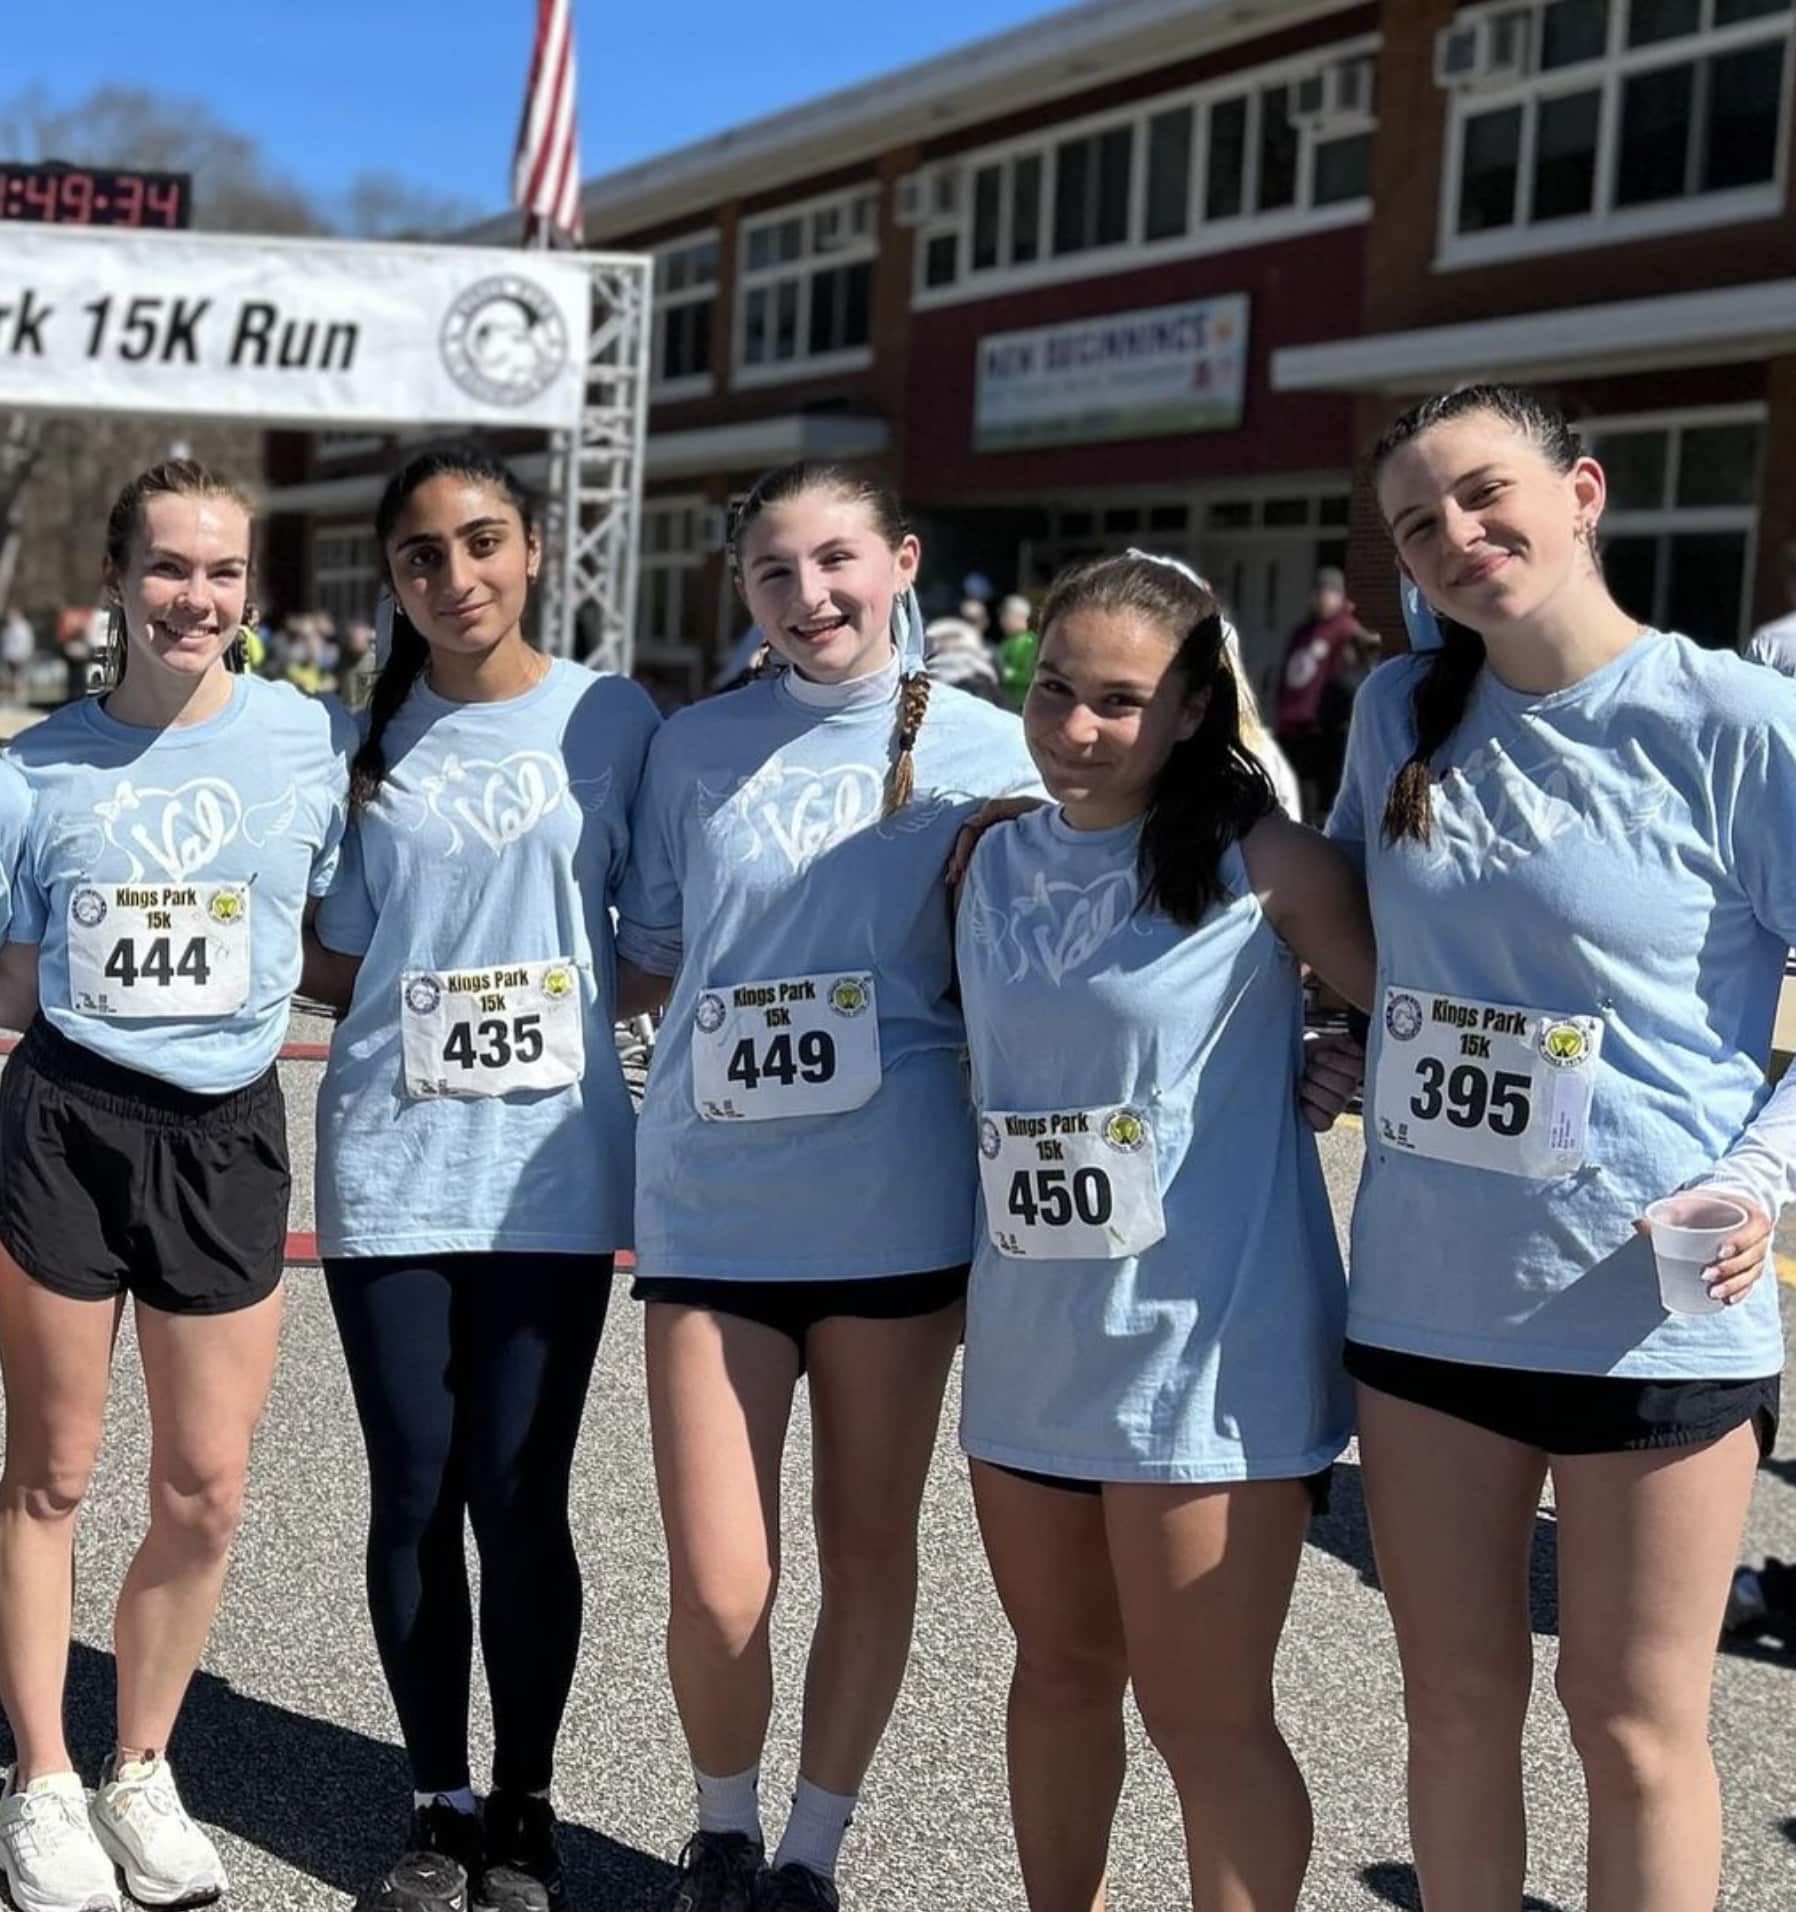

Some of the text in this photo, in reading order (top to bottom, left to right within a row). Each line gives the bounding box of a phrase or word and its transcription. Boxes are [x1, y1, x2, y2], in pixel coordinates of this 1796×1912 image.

[83, 292, 212, 364] 15K
[229, 299, 360, 372] Run
[116, 888, 158, 908] Kings
[163, 887, 197, 907] Park
[104, 936, 211, 988] 444
[448, 973, 491, 994] Kings
[494, 968, 529, 989] Park
[733, 987, 776, 1008] Kings
[779, 980, 816, 1002] Park
[1432, 998, 1480, 1029] Kings
[1482, 1007, 1528, 1036] Park
[443, 1014, 544, 1070] 435
[727, 1029, 837, 1090] 449
[1409, 1056, 1533, 1137] 395
[1005, 1115, 1047, 1138] Kings
[1051, 1111, 1089, 1135] Park
[1008, 1166, 1113, 1227] 450
